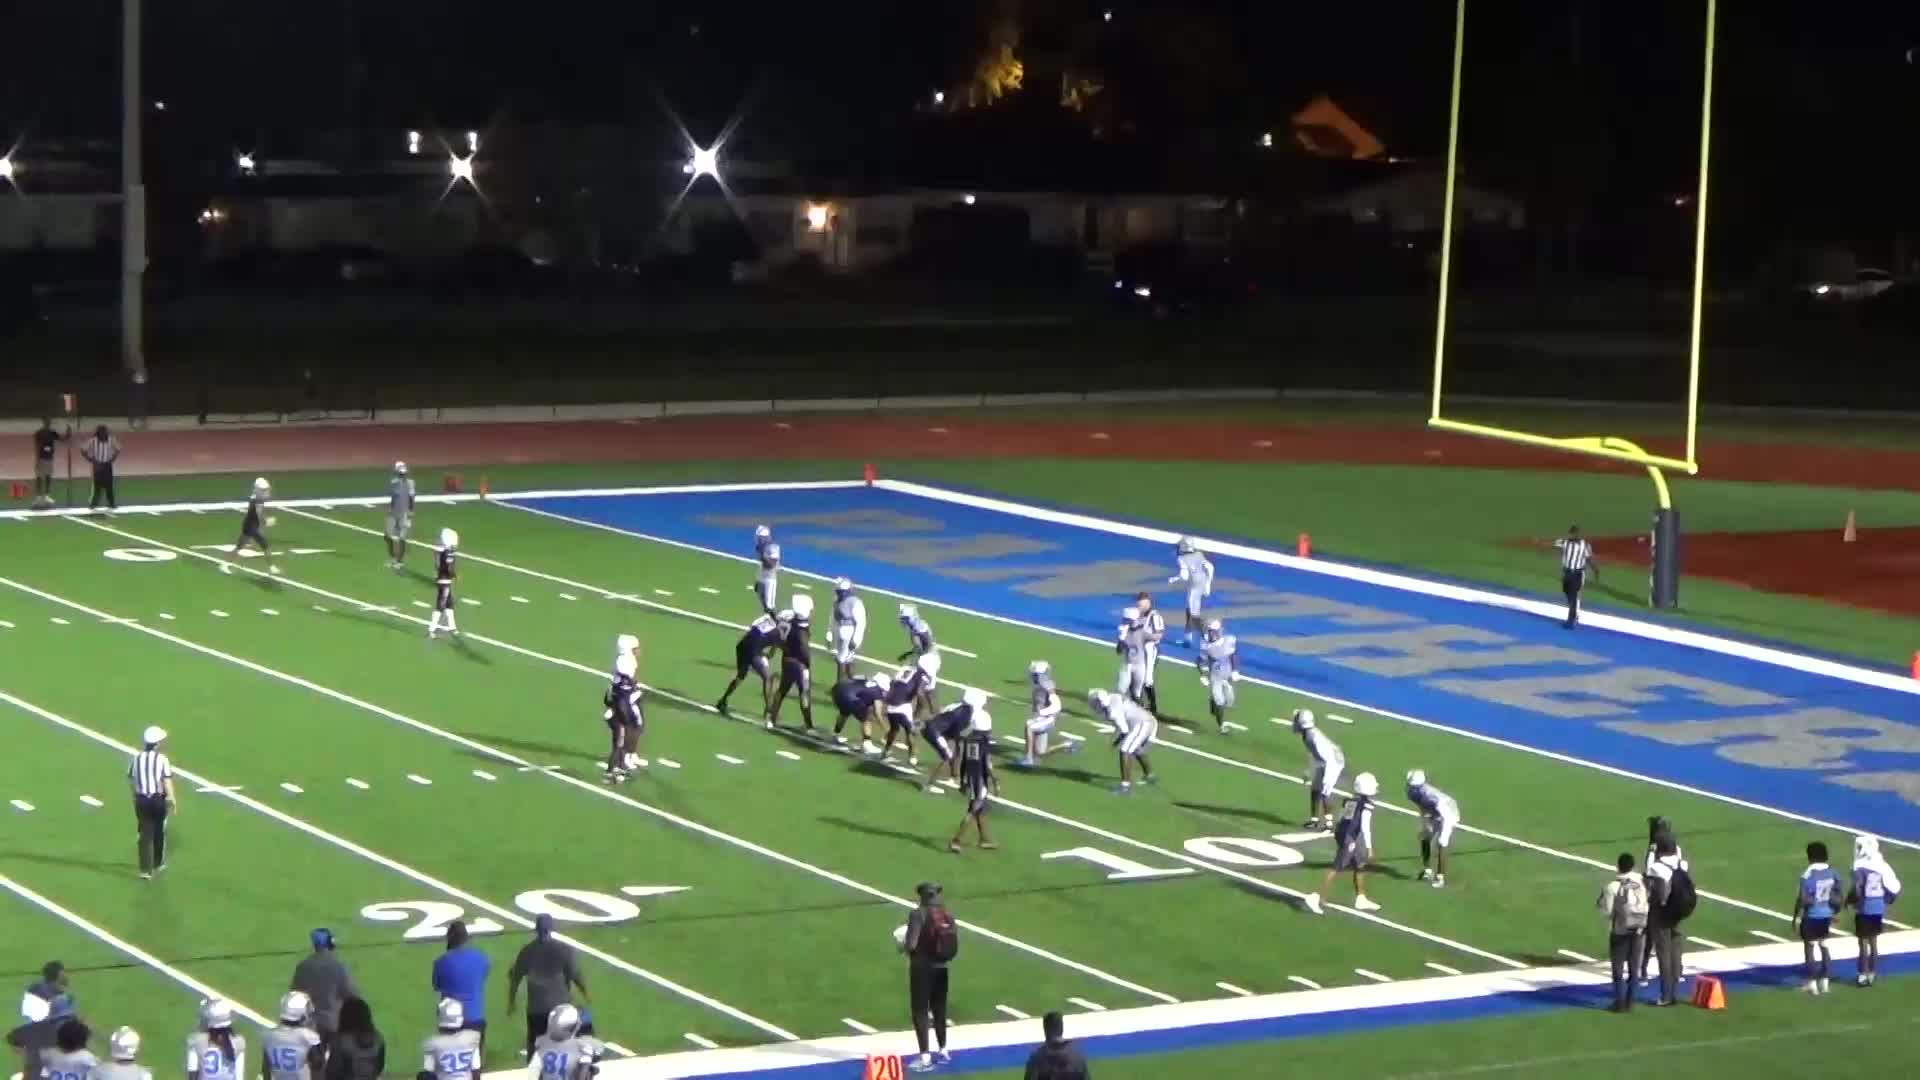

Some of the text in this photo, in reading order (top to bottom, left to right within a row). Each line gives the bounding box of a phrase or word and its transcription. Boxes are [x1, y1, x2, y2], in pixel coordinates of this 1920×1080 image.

[1040, 837, 1305, 880] 10
[360, 888, 640, 938] 20
[271, 1047, 297, 1072] 15
[543, 1050, 569, 1076] 81
[873, 1055, 900, 1080] 20
